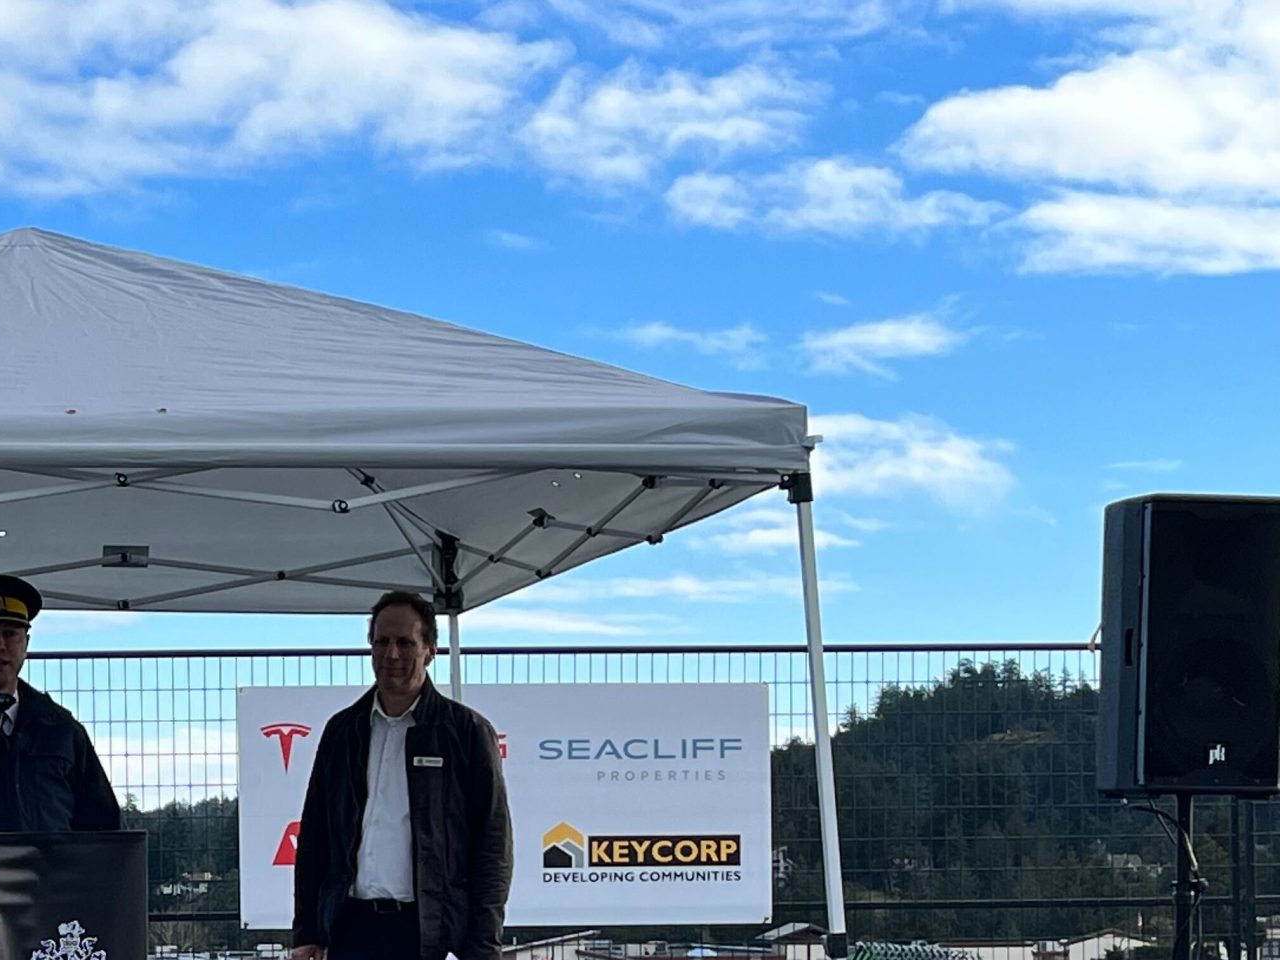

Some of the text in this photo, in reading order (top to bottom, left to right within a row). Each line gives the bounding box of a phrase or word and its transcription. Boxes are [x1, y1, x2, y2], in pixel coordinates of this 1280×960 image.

[538, 738, 743, 760] SEACLIFF
[596, 769, 726, 781] PROPERTIES
[591, 839, 738, 863] KEYCORP
[543, 870, 742, 883] DEVELOPING COMMUNITIES
